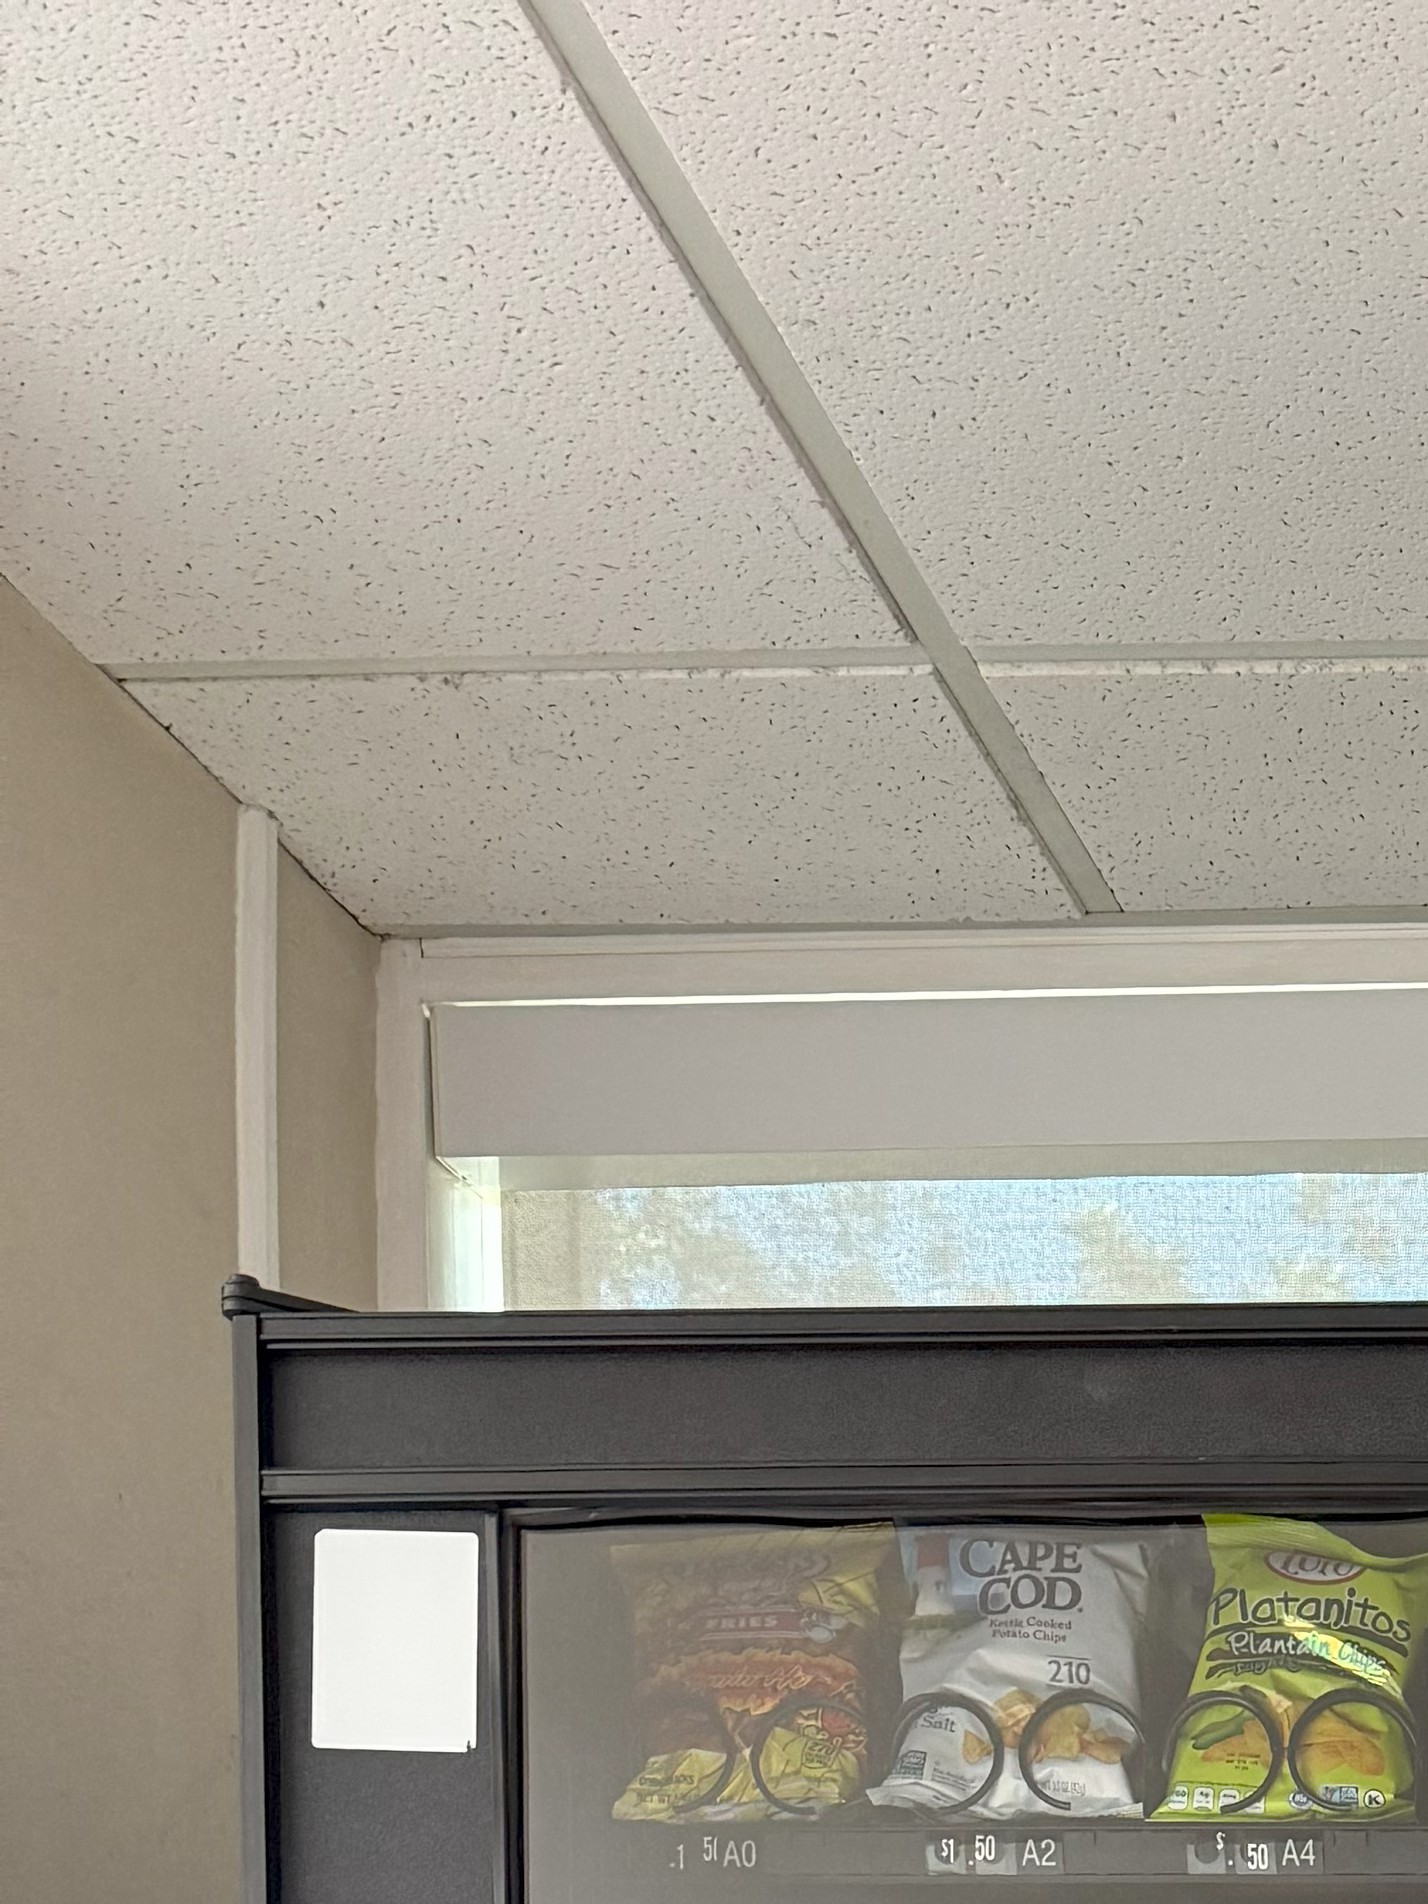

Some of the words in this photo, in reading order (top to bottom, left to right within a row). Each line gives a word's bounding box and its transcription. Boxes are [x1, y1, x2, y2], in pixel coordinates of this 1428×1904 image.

[960, 1537, 1083, 1577] CAPE
[978, 1575, 1080, 1616] COD
[1211, 1586, 1413, 1642] Platanitos
[1048, 1659, 1091, 1687] 210
[722, 1840, 757, 1868] A0
[1023, 1839, 1056, 1867] A2
[1282, 1839, 1315, 1867] A4
